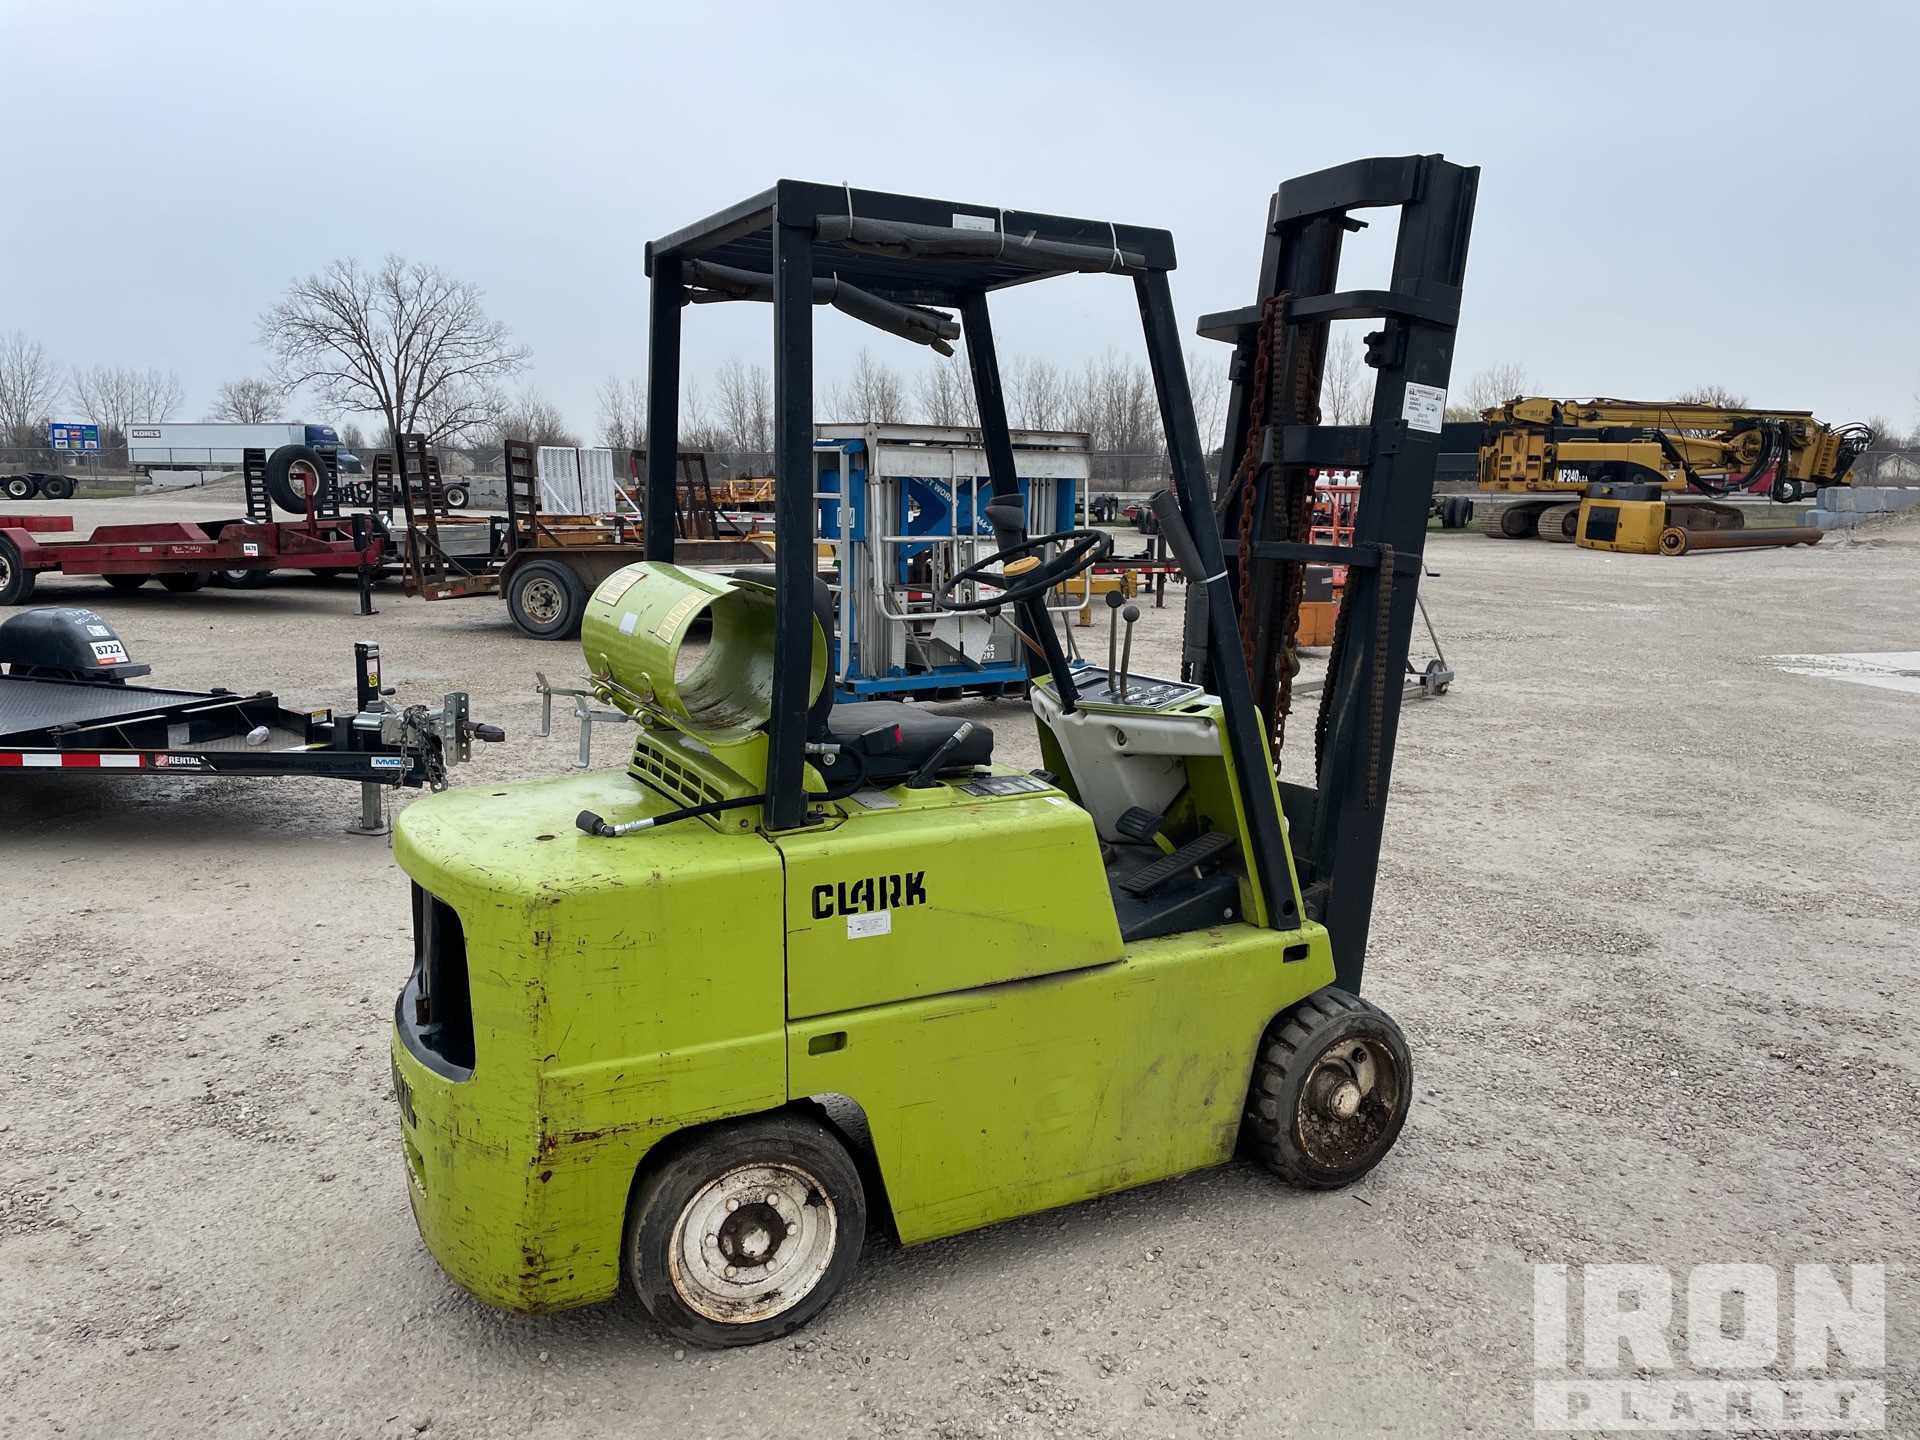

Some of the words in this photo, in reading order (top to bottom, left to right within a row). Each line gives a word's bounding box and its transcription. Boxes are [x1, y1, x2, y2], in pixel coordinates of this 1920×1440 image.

[1557, 469, 1579, 483] AF240
[96, 644, 121, 655] 8722
[168, 755, 202, 765] RENTAL
[812, 870, 927, 920] CLARK
